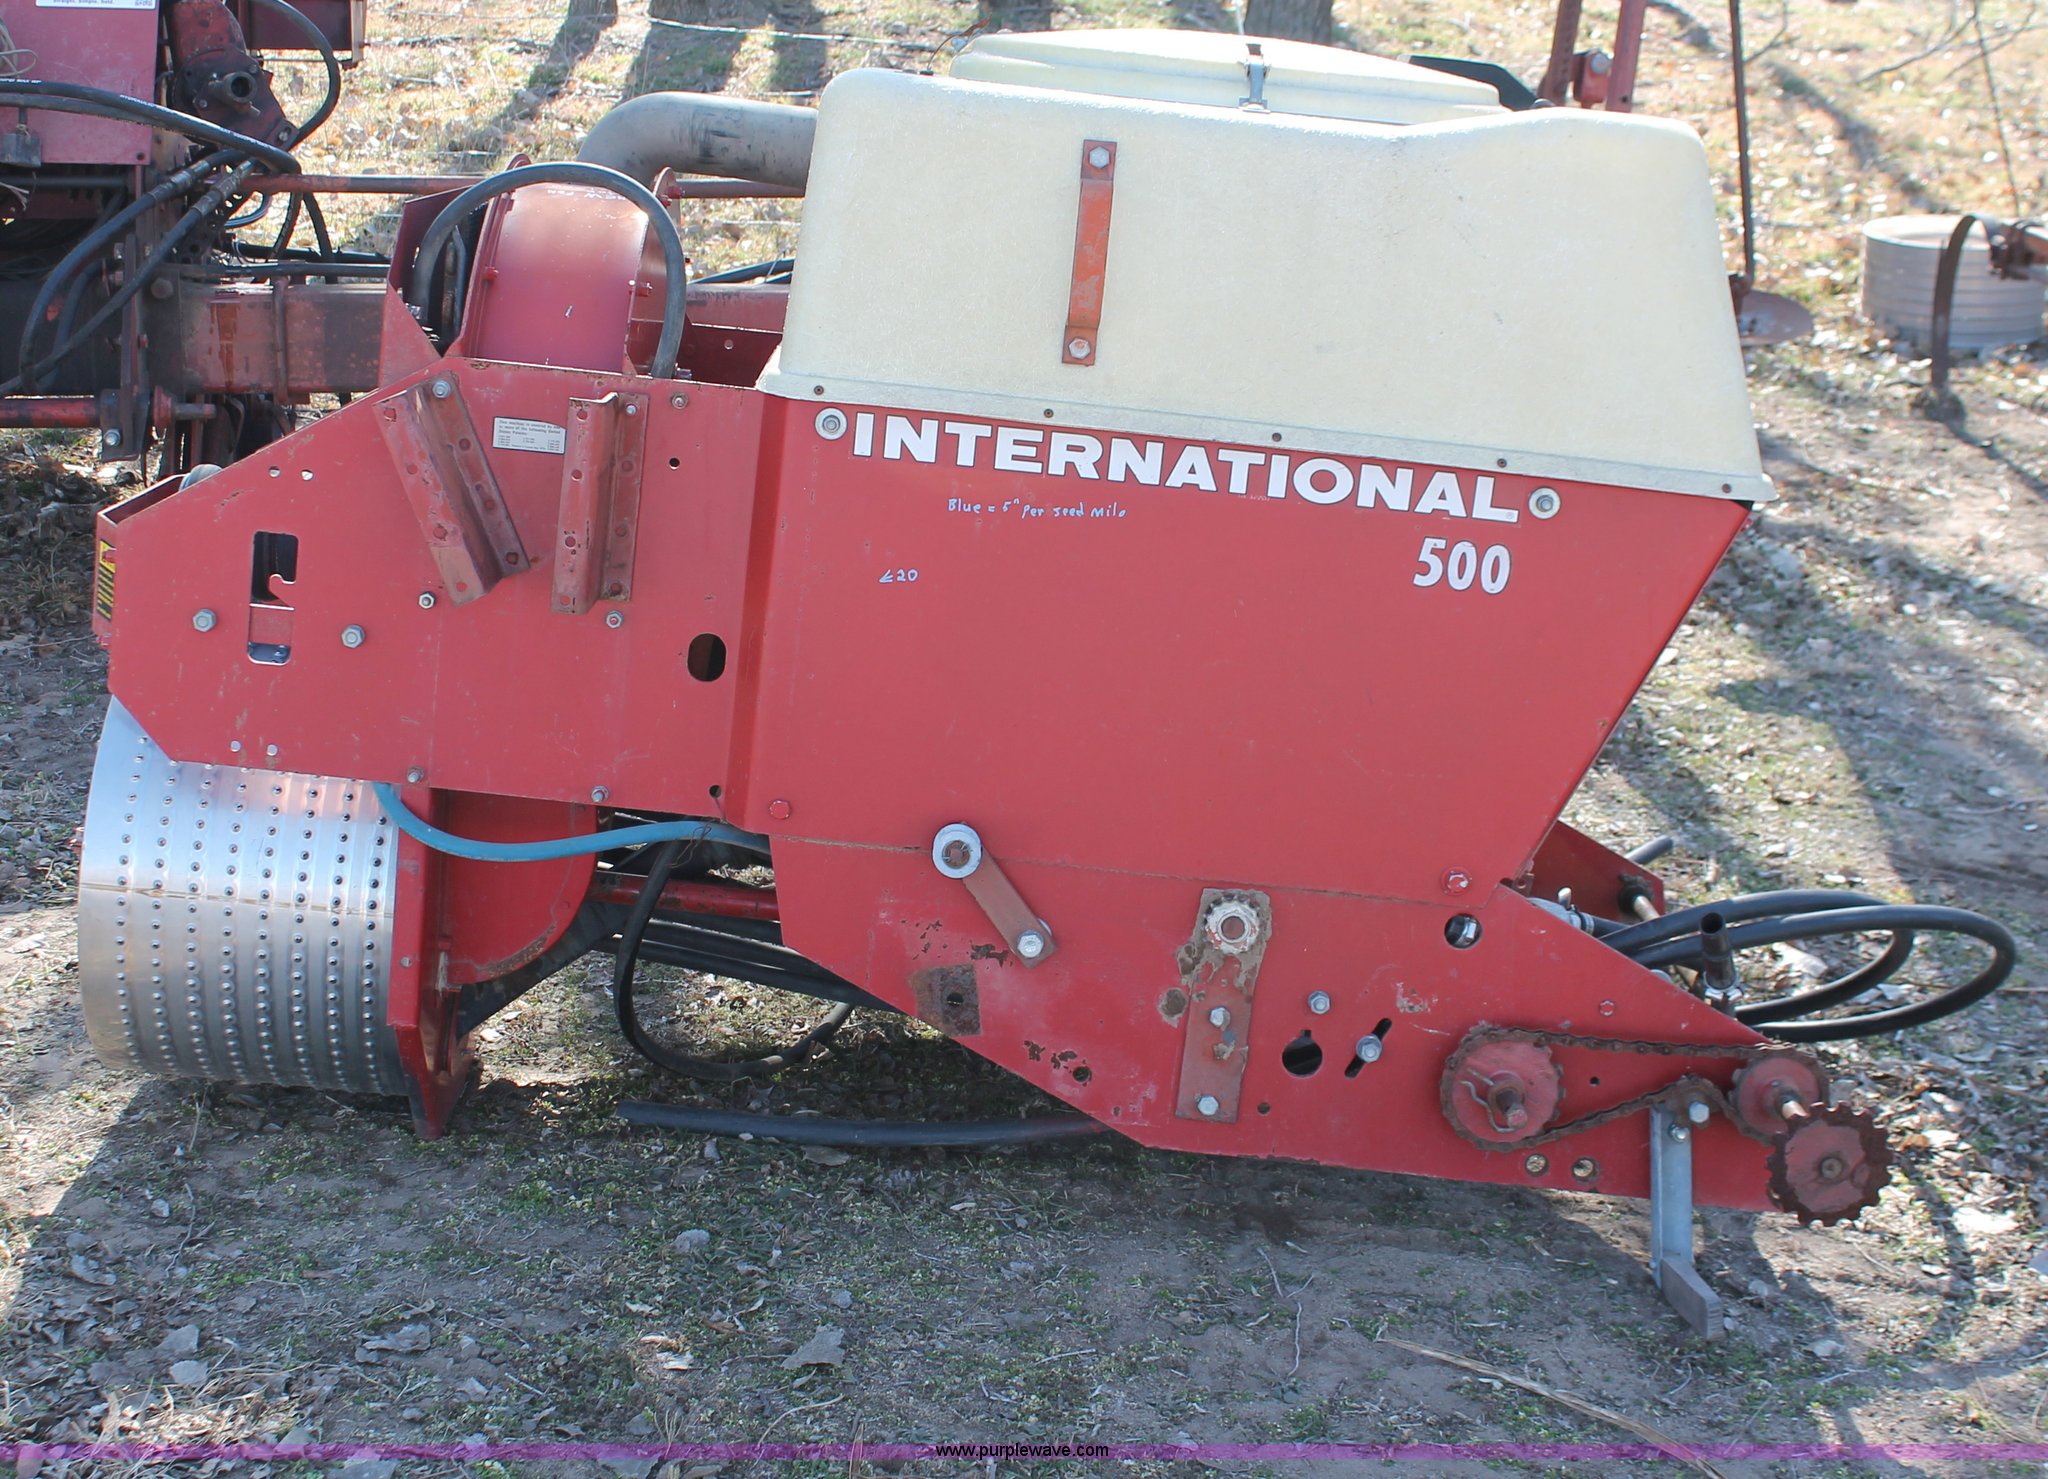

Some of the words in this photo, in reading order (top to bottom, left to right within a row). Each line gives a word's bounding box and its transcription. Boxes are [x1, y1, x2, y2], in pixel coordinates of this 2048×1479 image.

[852, 411, 1520, 523] INTERNATIONAL
[947, 499, 982, 513] Blue
[1412, 536, 1512, 595] 500
